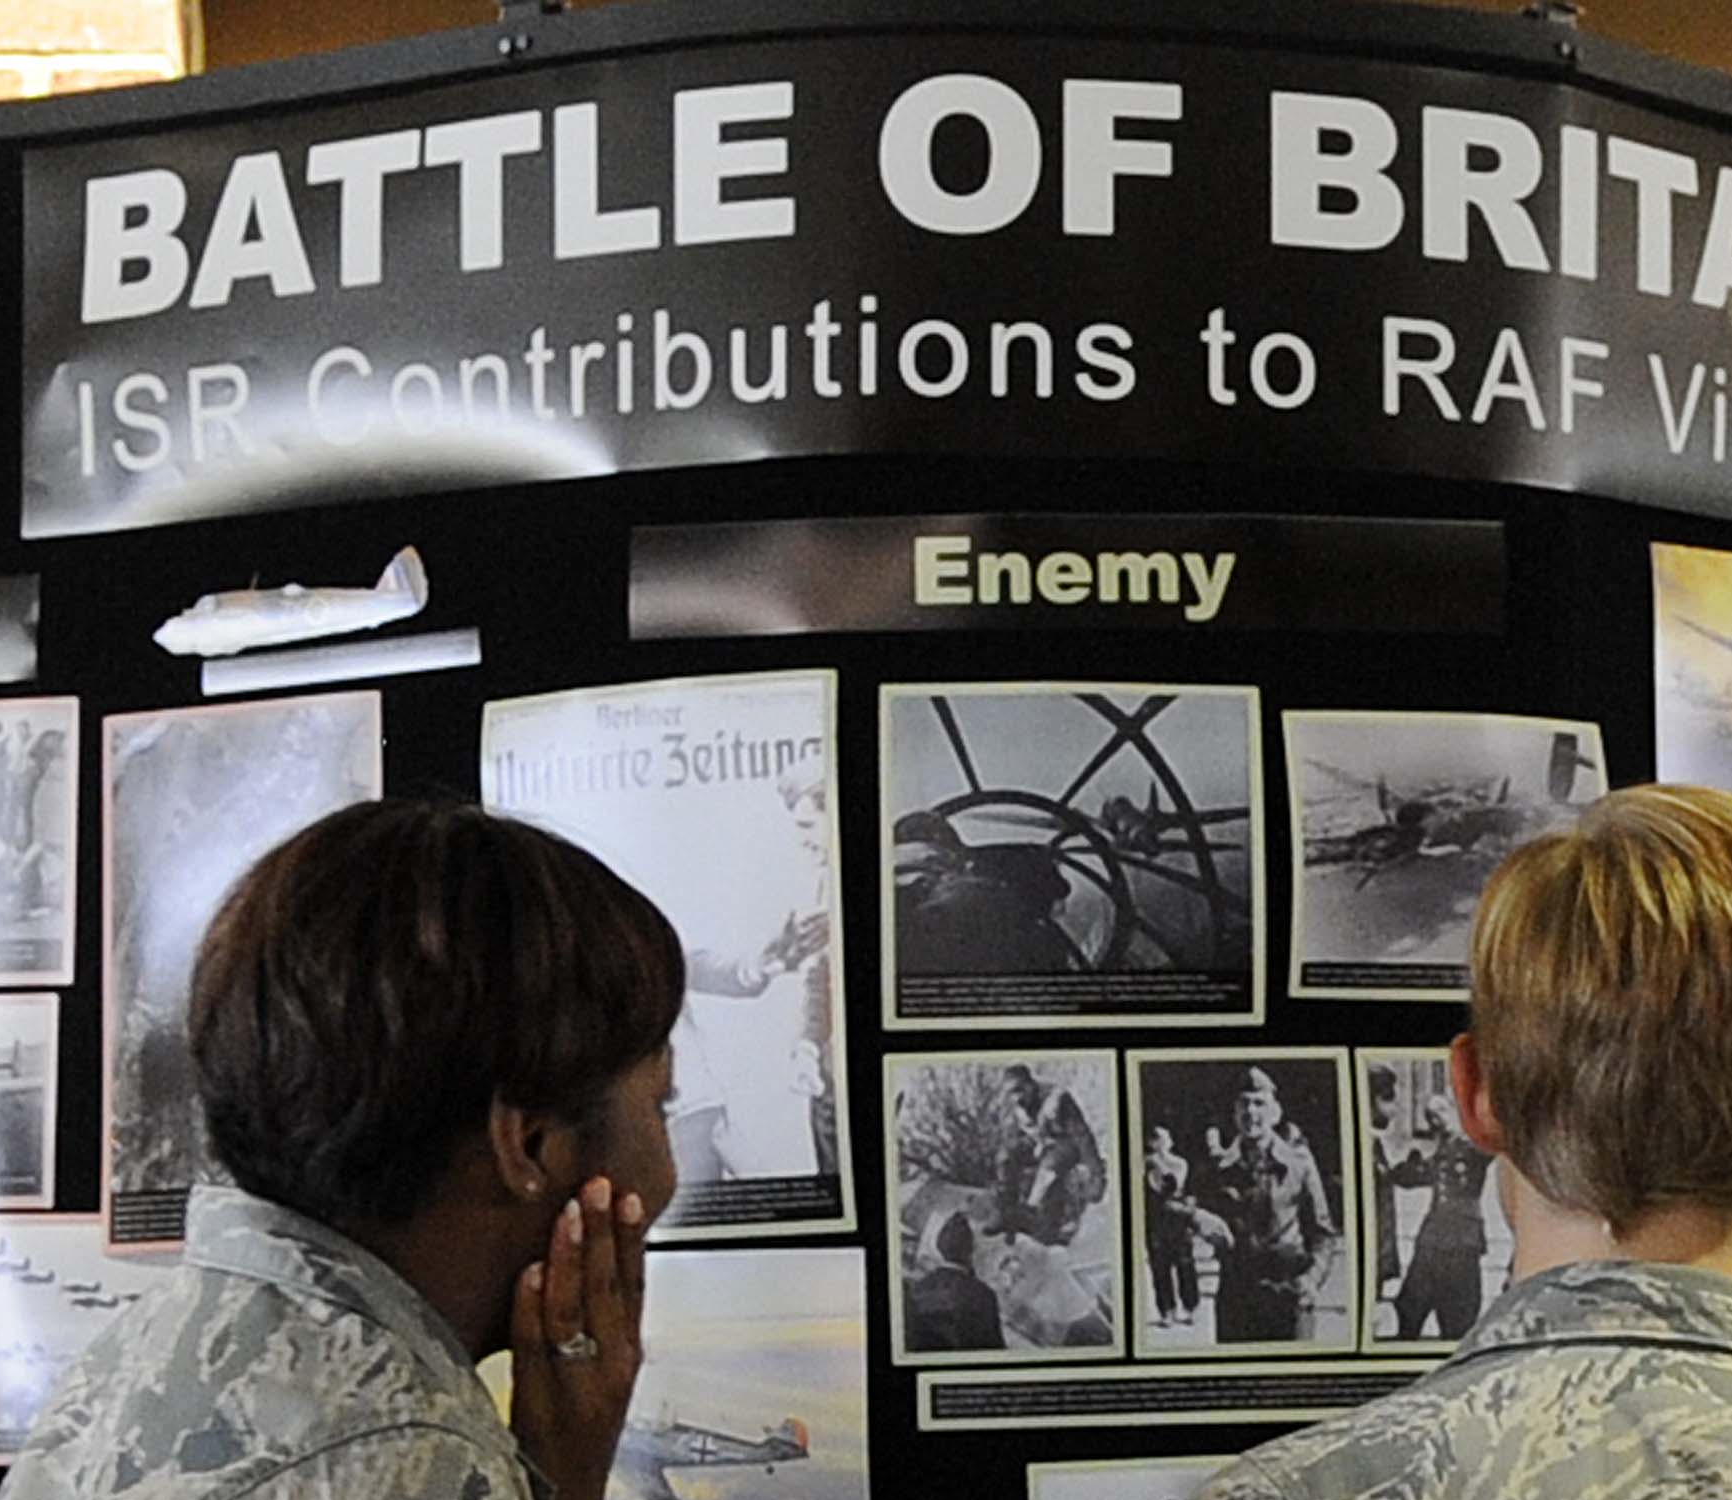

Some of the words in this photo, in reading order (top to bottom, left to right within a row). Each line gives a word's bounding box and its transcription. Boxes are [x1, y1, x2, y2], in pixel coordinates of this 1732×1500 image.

[81, 81, 796, 324] BATTLE
[879, 73, 1183, 236] OF
[77, 361, 259, 478] ISR
[306, 294, 1137, 446] Contributions
[1200, 306, 1317, 410] to
[1382, 315, 1611, 434] RAF
[913, 535, 1236, 622] Enemy
